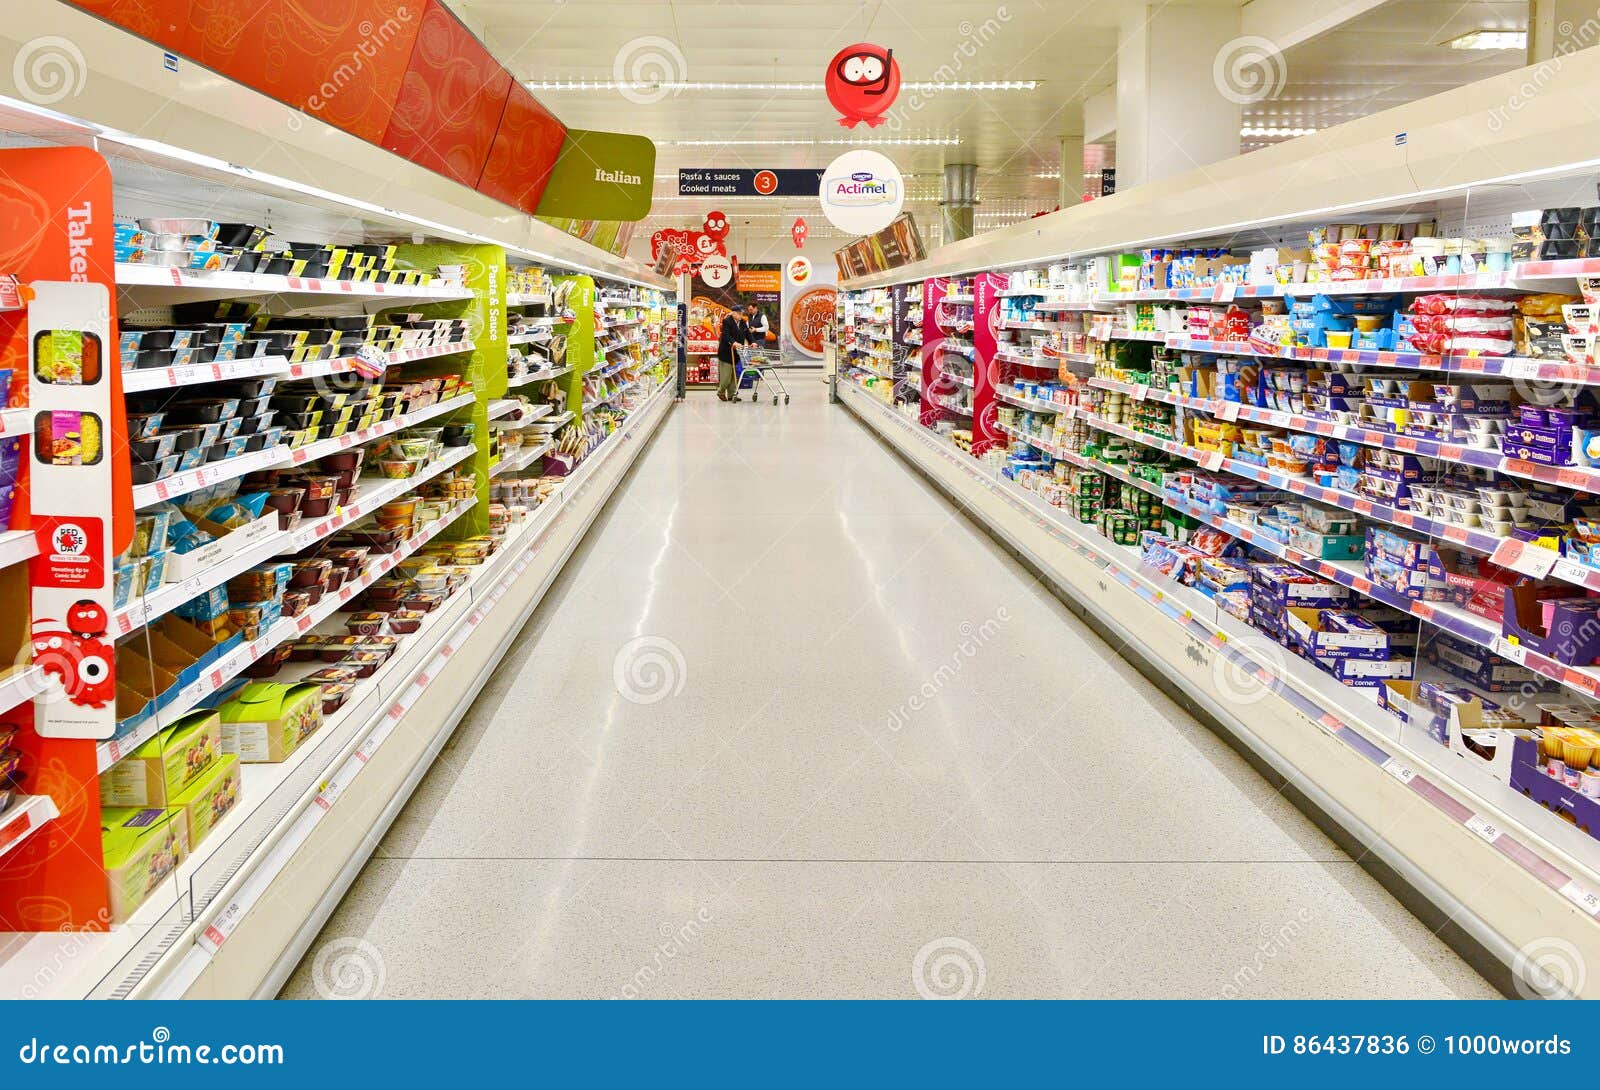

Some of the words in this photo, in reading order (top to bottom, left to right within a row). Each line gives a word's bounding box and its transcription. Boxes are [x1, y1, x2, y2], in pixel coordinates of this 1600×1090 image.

[595, 168, 642, 185] Italian
[680, 172, 702, 181] Pasta
[705, 172, 711, 181] &
[761, 176, 770, 188] 3
[1103, 173, 1115, 181] Ba
[680, 184, 709, 192] Cooked
[837, 183, 887, 194] Actimel
[667, 232, 688, 245] Red
[488, 264, 499, 295] Pasta
[489, 297, 500, 306] &
[927, 283, 935, 310] Desserts
[978, 281, 986, 314] Desserts
[489, 308, 500, 341] Sauce
[1302, 320, 1315, 328] Rice
[1478, 405, 1505, 413] corner
[60, 528, 79, 537] RED
[56, 537, 83, 545] NSE
[60, 544, 79, 552] DAY
[1449, 575, 1475, 587] corner
[1467, 602, 1486, 614] corner
